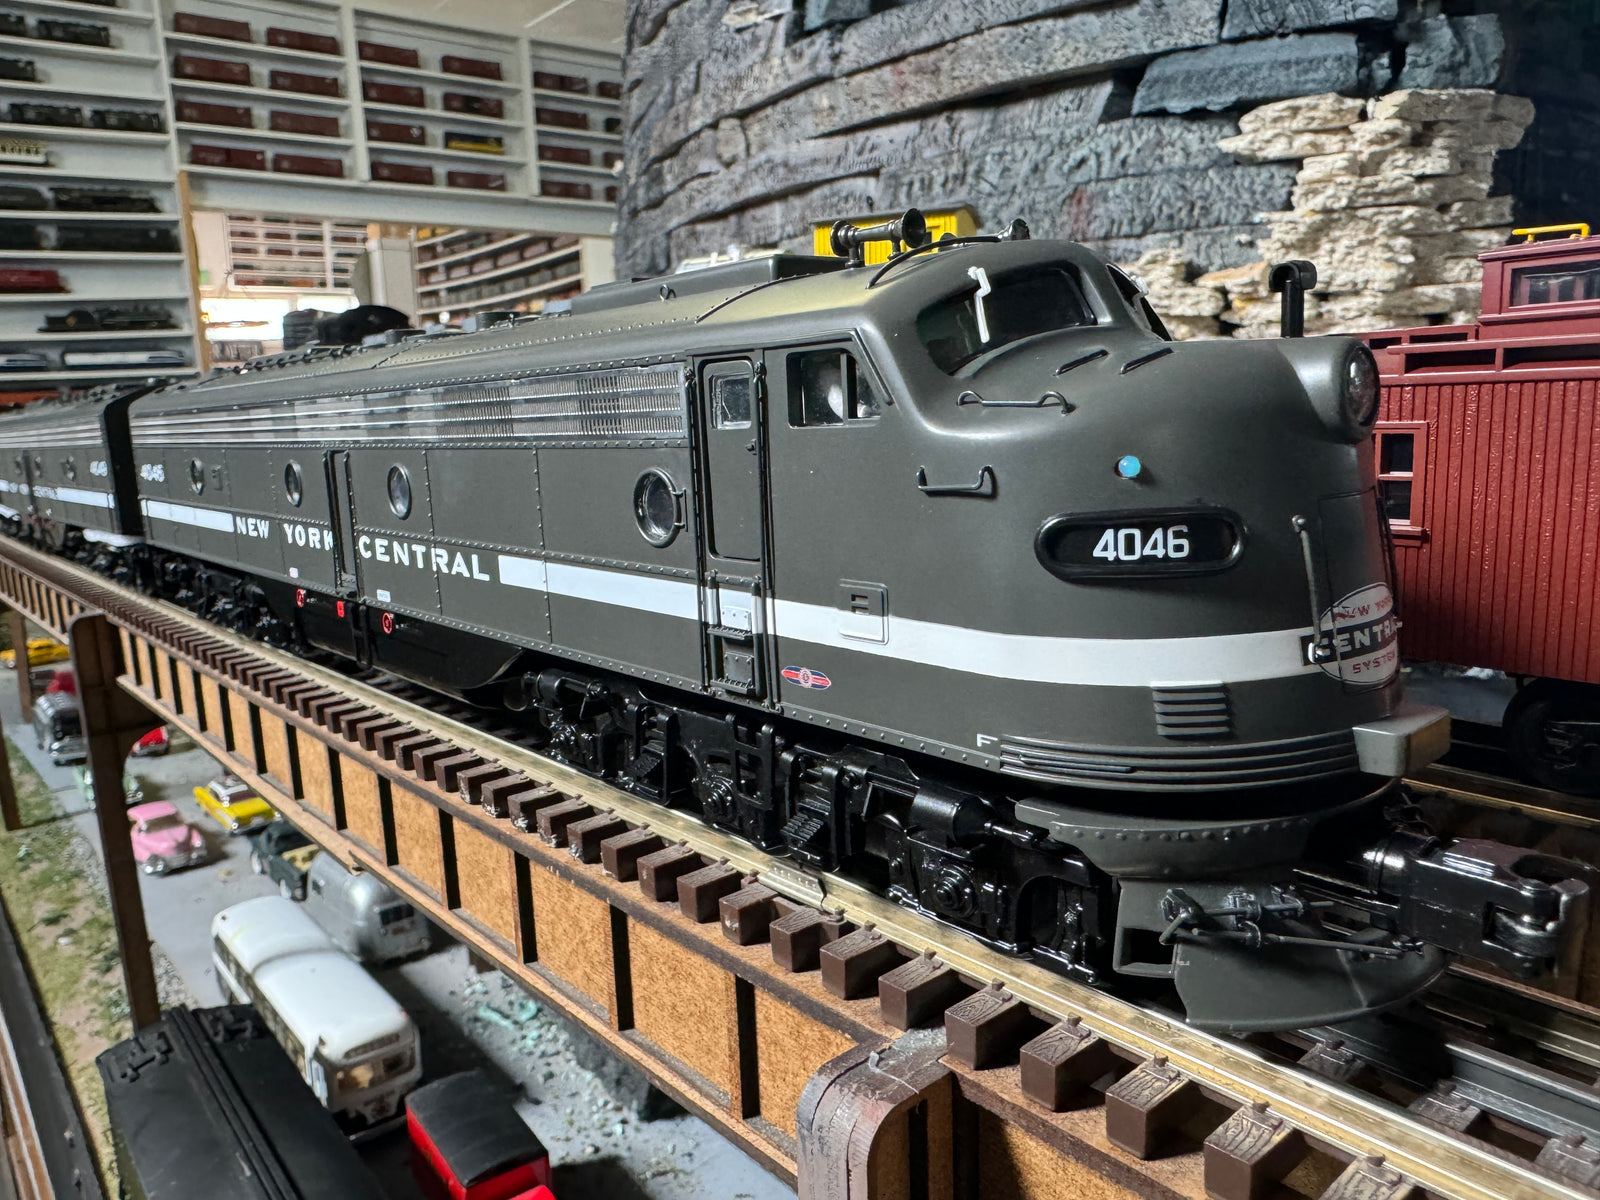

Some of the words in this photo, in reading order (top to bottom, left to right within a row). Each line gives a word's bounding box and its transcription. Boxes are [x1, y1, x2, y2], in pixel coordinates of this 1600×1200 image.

[235, 516, 270, 539] NEW
[283, 523, 334, 551] YORK
[358, 535, 490, 582] CENTRAL
[1092, 524, 1190, 561] 4046
[976, 733, 999, 747] F
